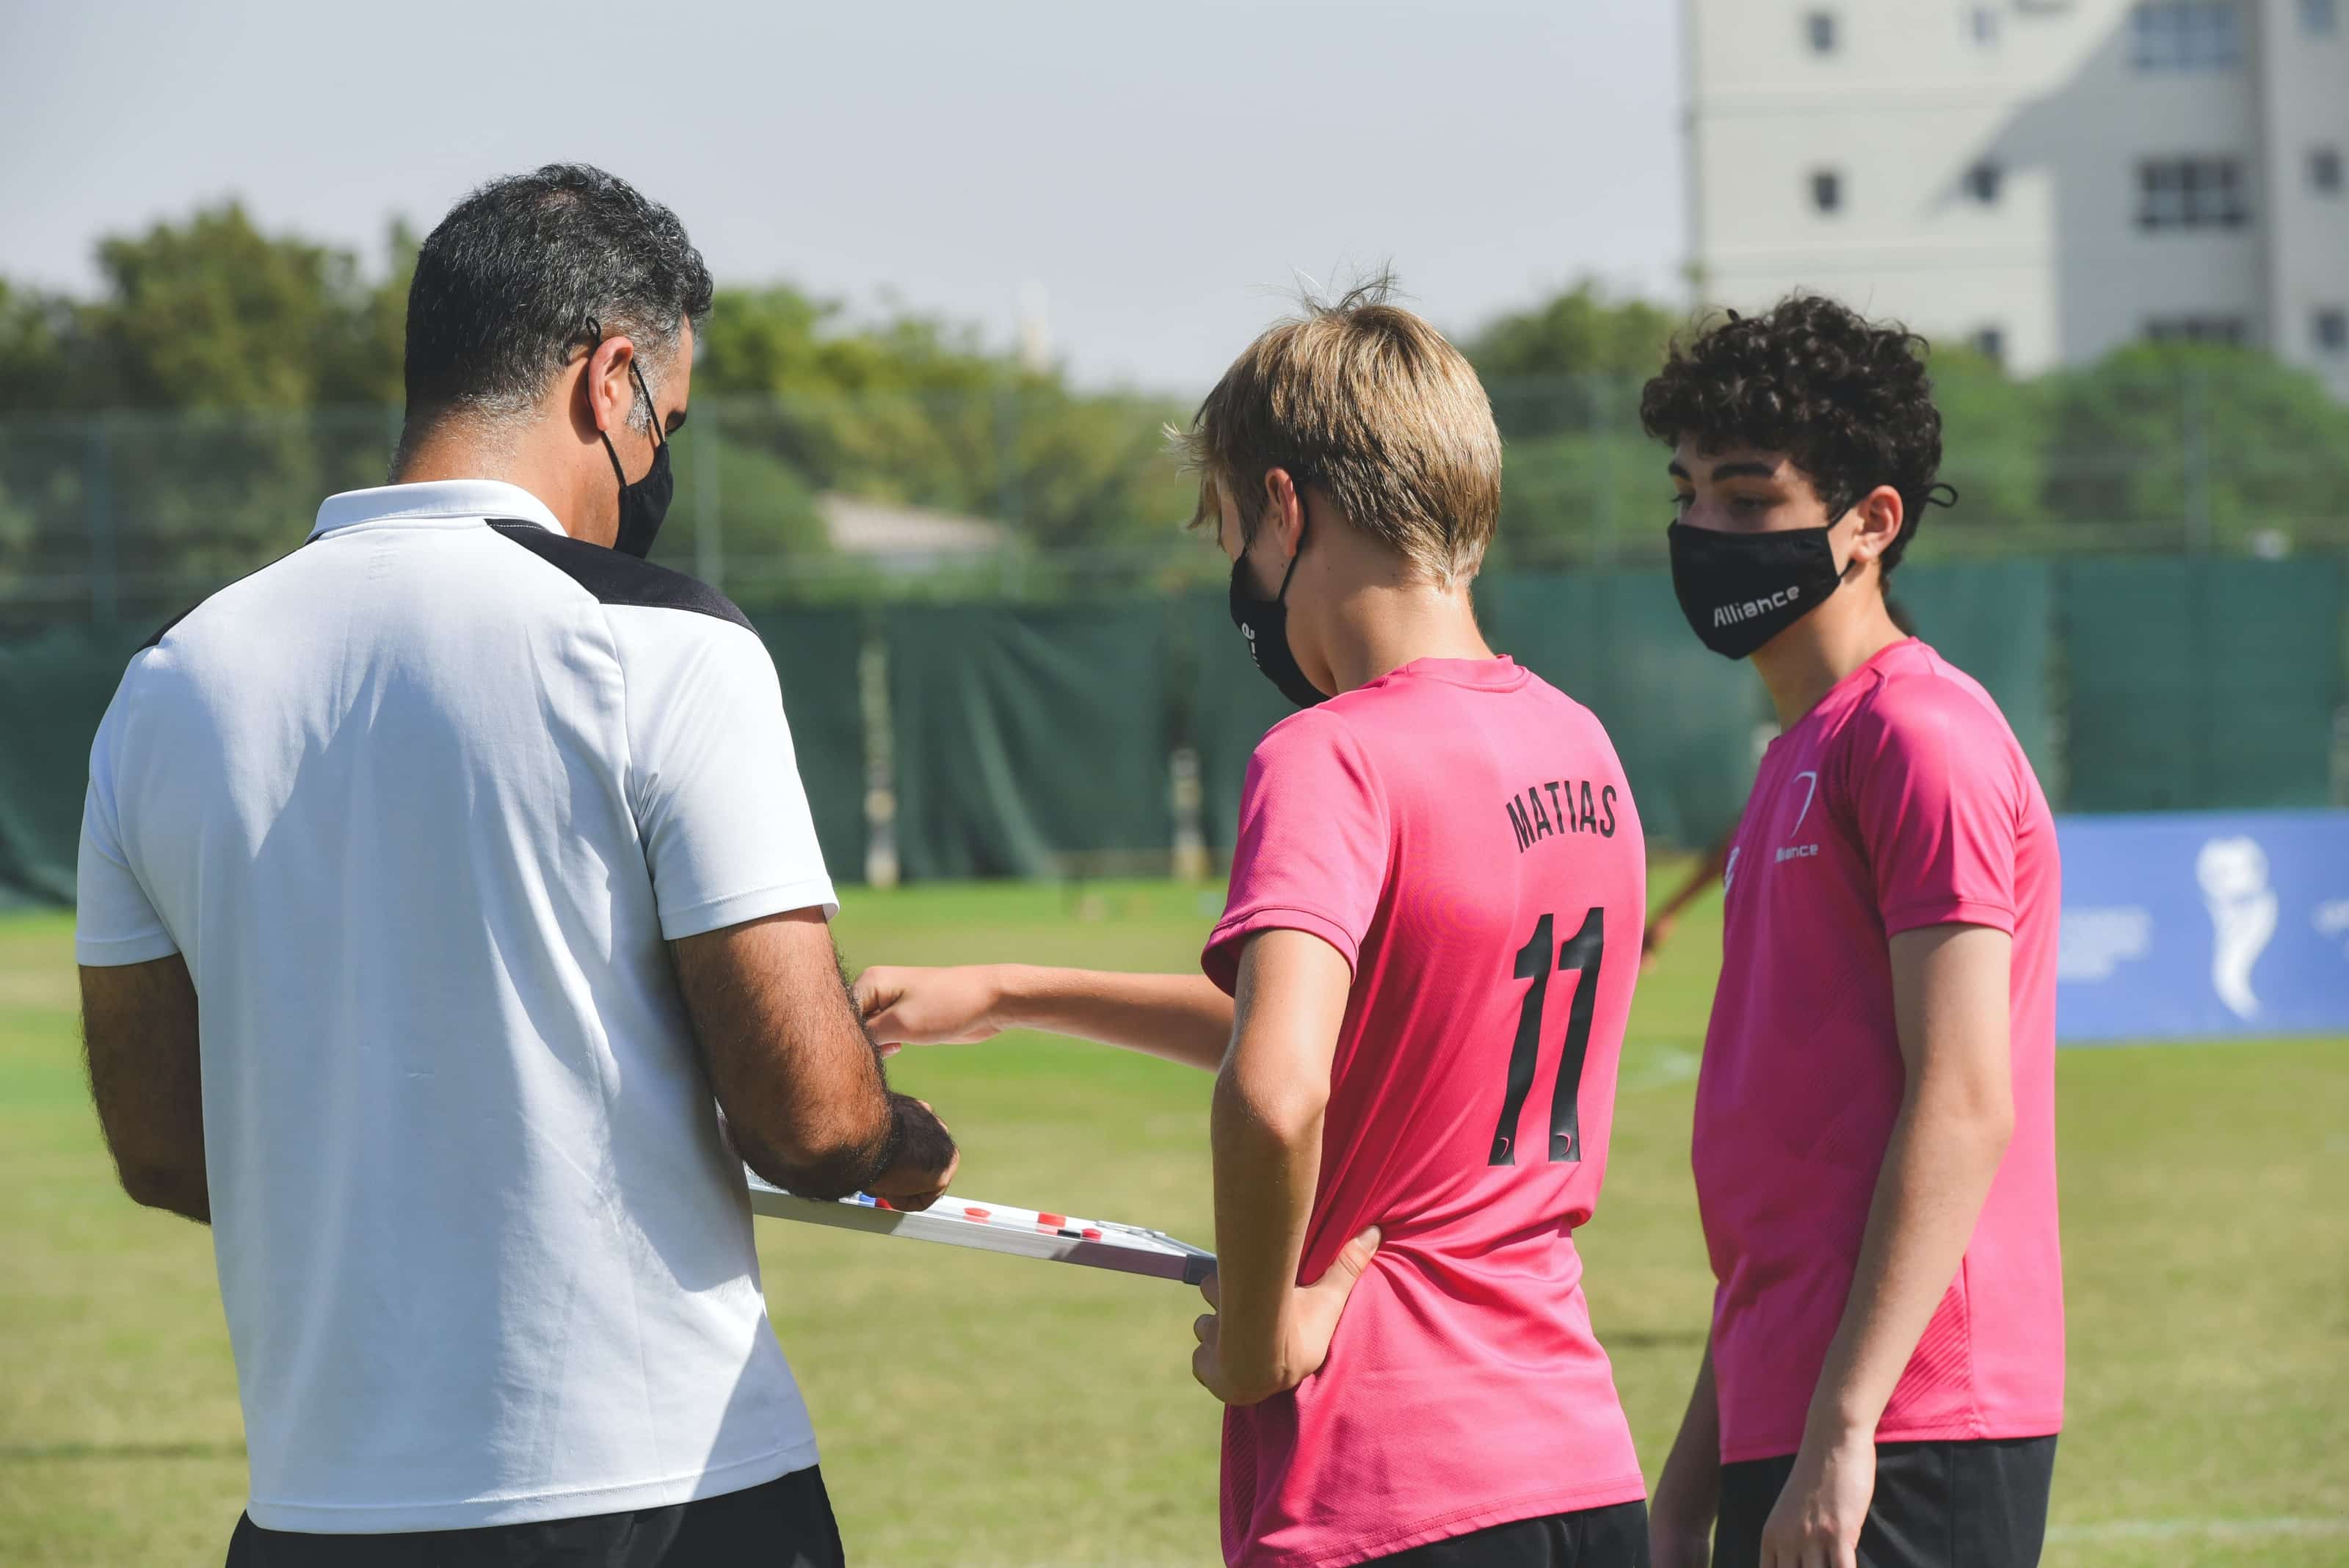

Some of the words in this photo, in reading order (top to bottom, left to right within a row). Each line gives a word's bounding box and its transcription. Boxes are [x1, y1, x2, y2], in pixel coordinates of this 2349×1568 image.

[1713, 586, 1800, 628] Alliance
[1506, 780, 1616, 853] MATIAS
[1487, 907, 1604, 1166] 11
